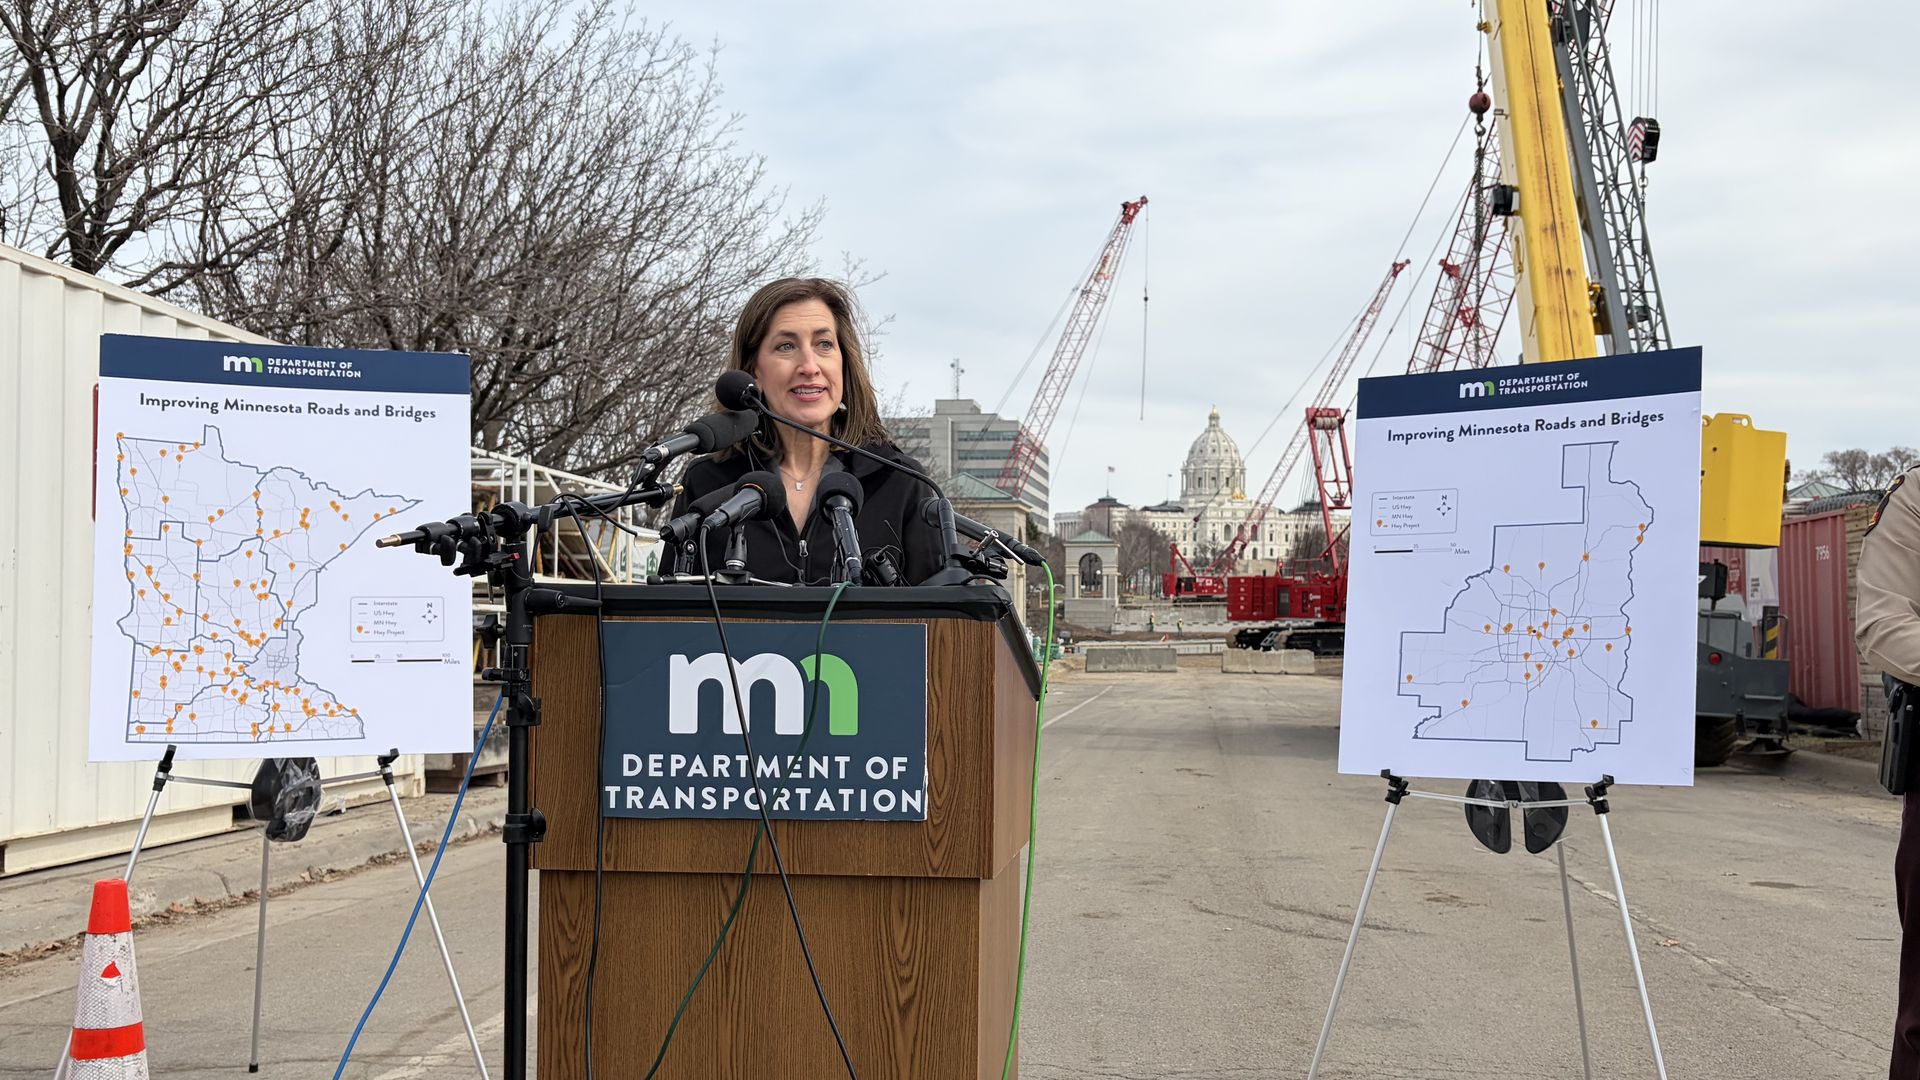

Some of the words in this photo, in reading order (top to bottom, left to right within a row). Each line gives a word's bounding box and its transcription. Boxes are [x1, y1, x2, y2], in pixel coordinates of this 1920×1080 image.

[223, 355, 263, 373] mn
[267, 357, 336, 369] DEPARTMENT
[339, 361, 353, 370] OF
[267, 366, 362, 378] TRANSPORTATION
[1498, 380, 1589, 395] TRANSPORTATION
[1499, 374, 1564, 387] DEPARTMENT
[1566, 372, 1580, 381] OF
[1459, 381, 1495, 399] mn
[140, 392, 220, 415] Improving
[223, 398, 303, 414] Minnesota
[307, 401, 350, 416] Roads
[354, 404, 380, 417] and
[385, 404, 437, 423] Bridges
[1387, 426, 1455, 445] Improving
[1458, 423, 1531, 438] Minnesota
[1534, 416, 1577, 432] Roads
[1579, 413, 1606, 428] and
[1610, 410, 1665, 428] Bridges
[622, 754, 851, 780] DEPARTMENT
[865, 756, 908, 780] OF
[605, 785, 922, 813] TRANSPORTATION
